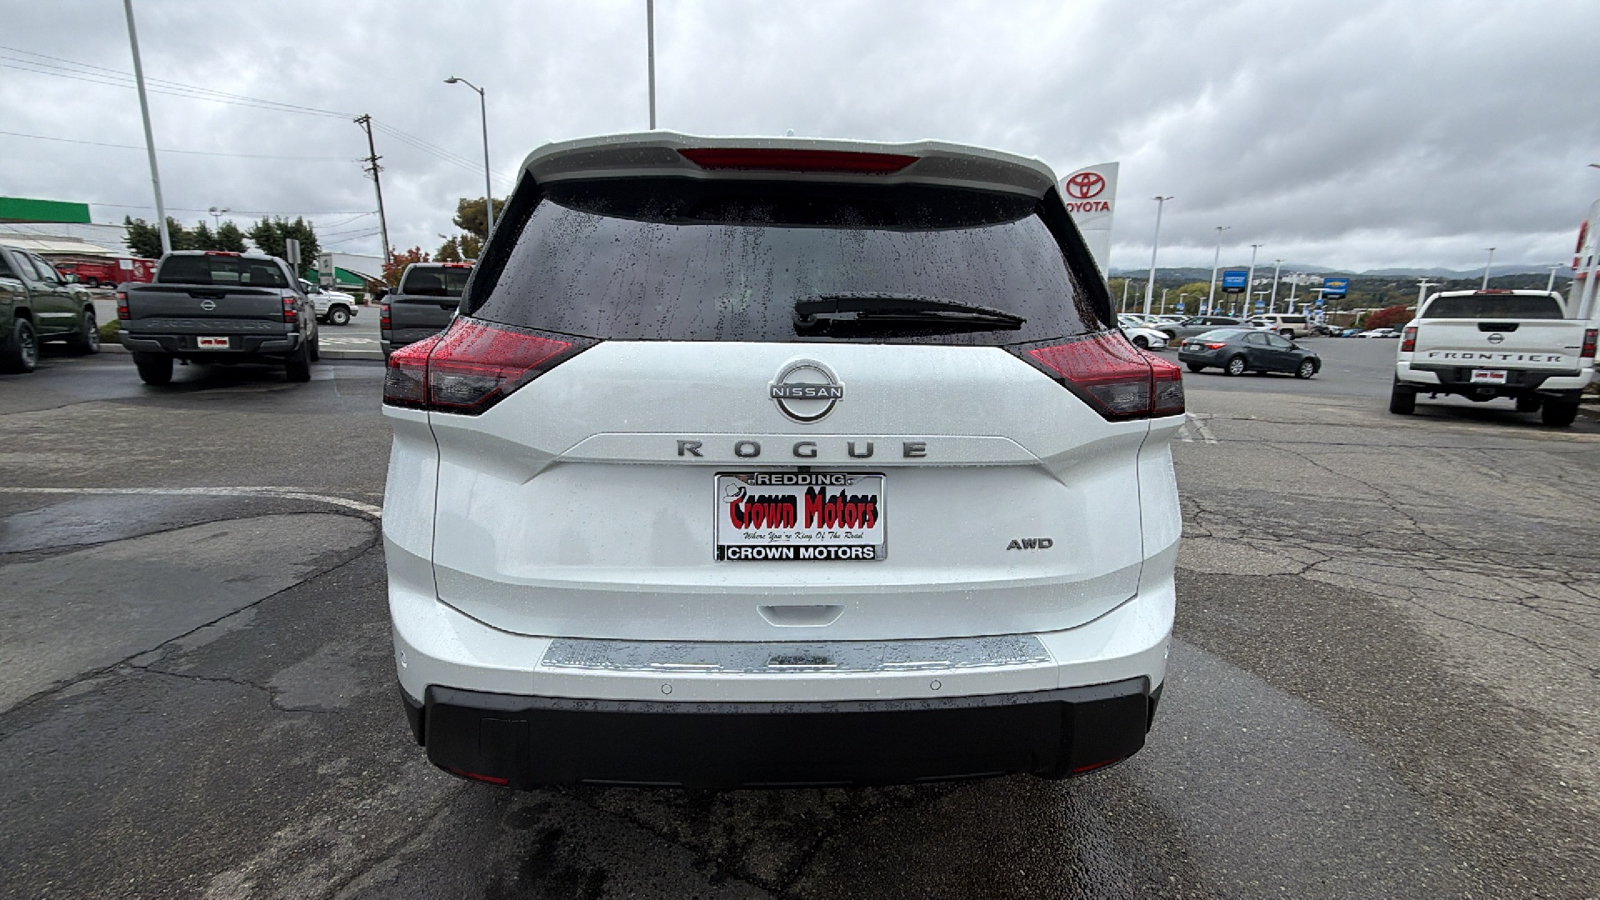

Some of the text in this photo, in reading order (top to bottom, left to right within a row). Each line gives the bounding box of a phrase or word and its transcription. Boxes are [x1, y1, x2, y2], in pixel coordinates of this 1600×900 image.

[1066, 201, 1110, 213] OYOTA
[1428, 352, 1562, 363] FRONTIER
[772, 387, 842, 397] NISSAN
[677, 440, 927, 458] ROGUE
[757, 474, 846, 485] REDDING
[729, 487, 878, 530] Crown Motors
[743, 532, 864, 543] Where You're King Of The Road
[1006, 538, 1053, 550] AWD
[727, 547, 874, 559] CROWN MOTORS
